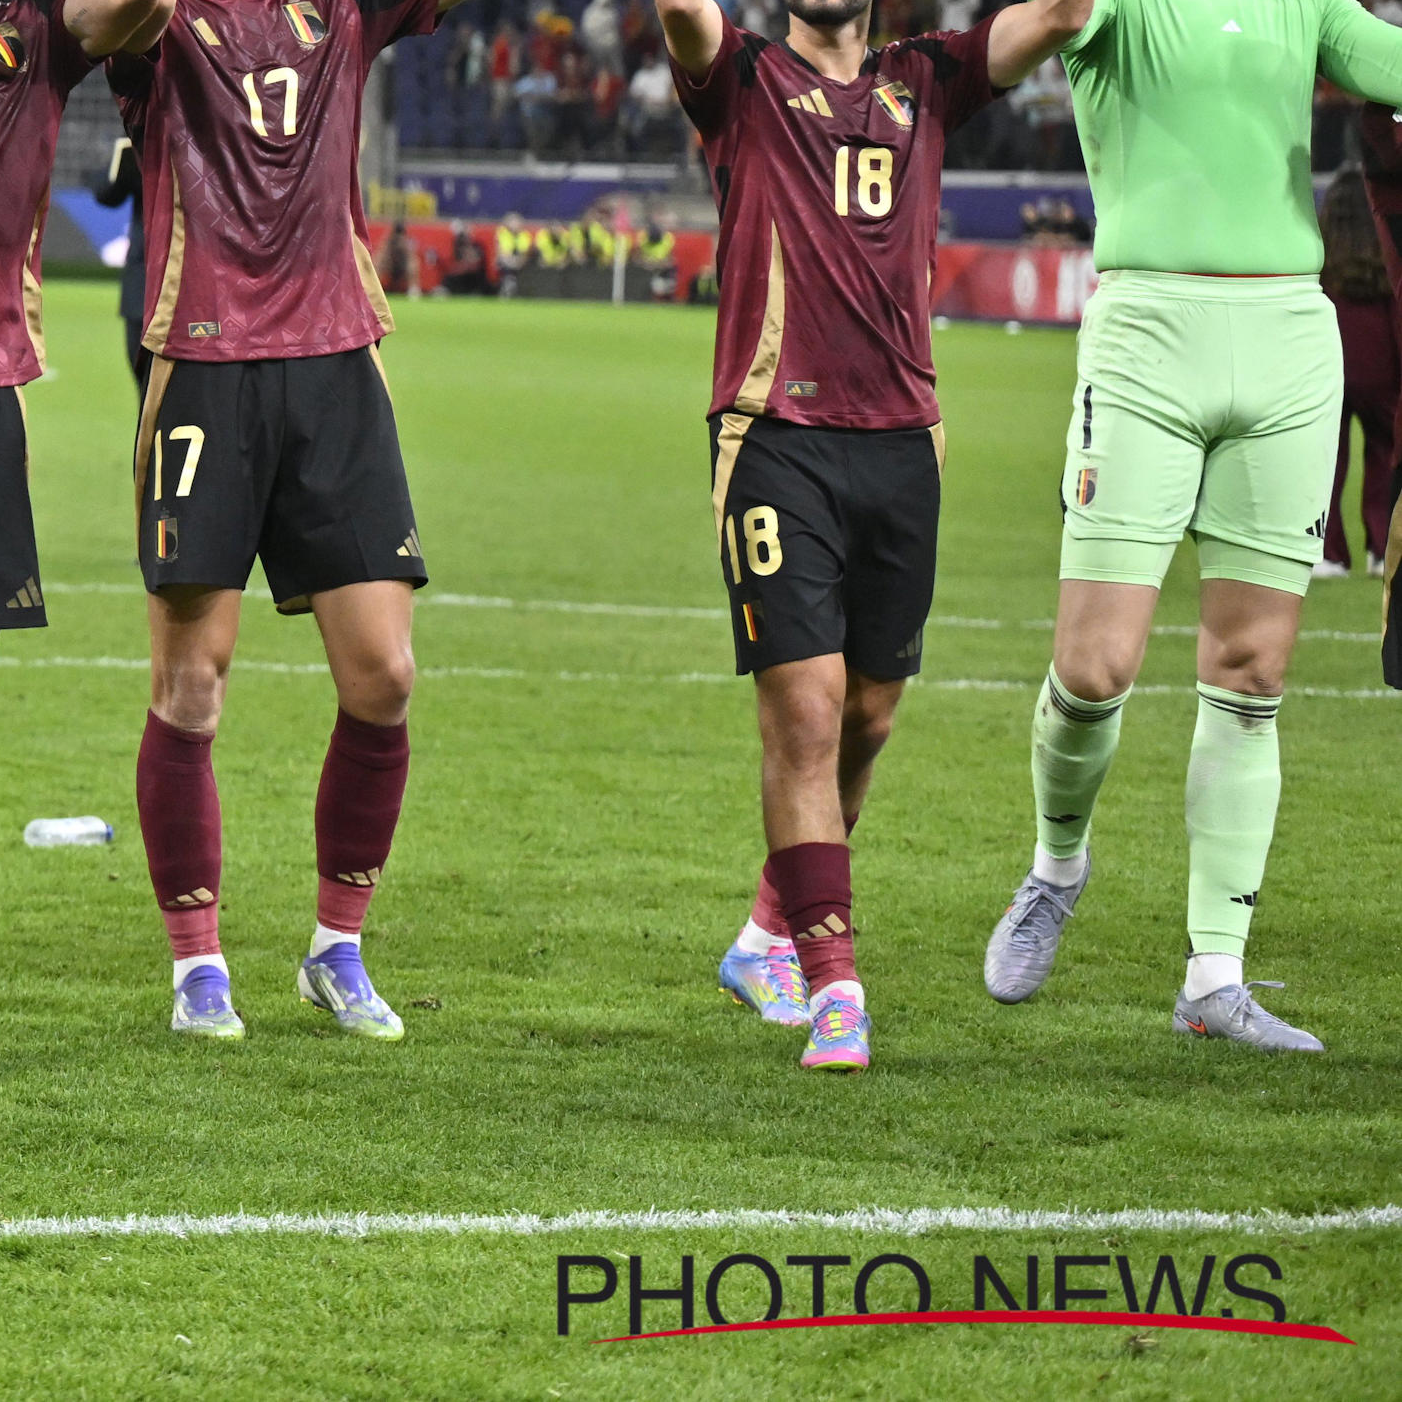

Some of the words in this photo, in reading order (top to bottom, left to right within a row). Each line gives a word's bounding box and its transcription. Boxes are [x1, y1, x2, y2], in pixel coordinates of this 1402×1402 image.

[242, 67, 299, 137] 17
[834, 146, 894, 217] 18
[154, 425, 205, 498] 17
[725, 505, 784, 586] 18
